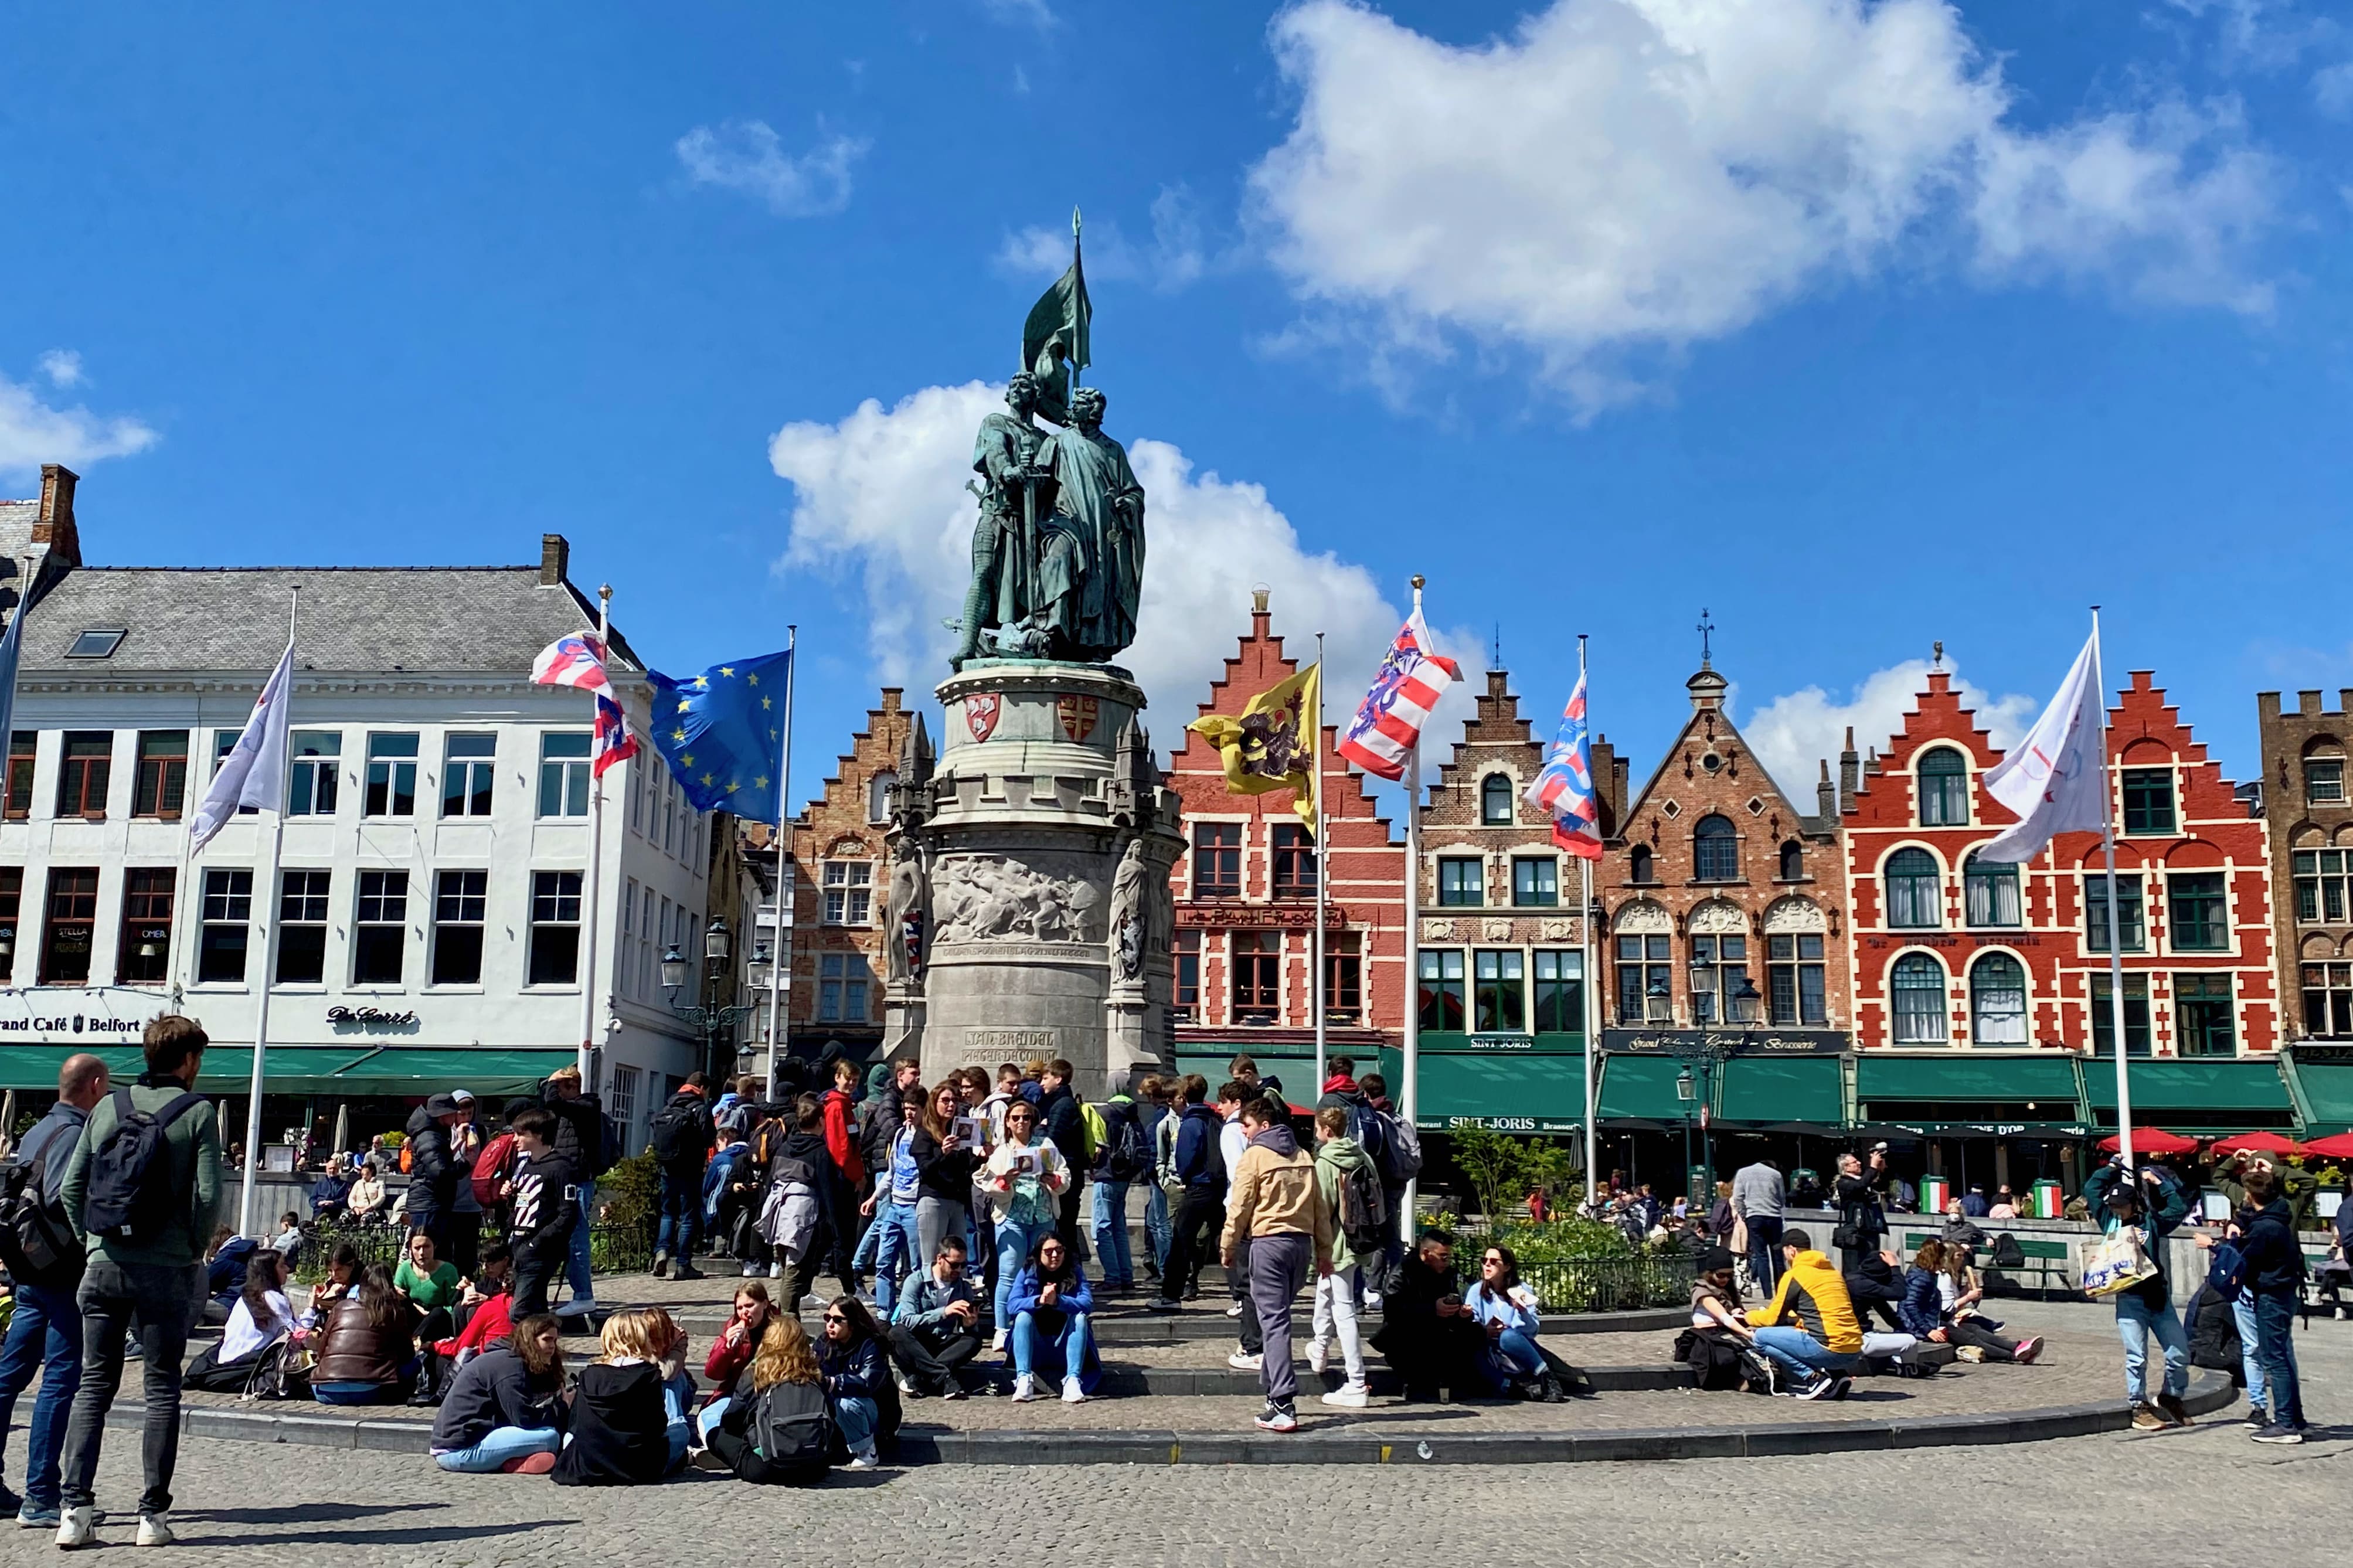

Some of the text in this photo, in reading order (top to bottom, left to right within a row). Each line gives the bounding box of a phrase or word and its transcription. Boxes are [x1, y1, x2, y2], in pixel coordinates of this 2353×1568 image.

[0, 1018, 140, 1032] and Café Belfort
[1471, 1038, 1532, 1048] SINT JORIS
[1764, 1038, 1817, 1049] Brasserie
